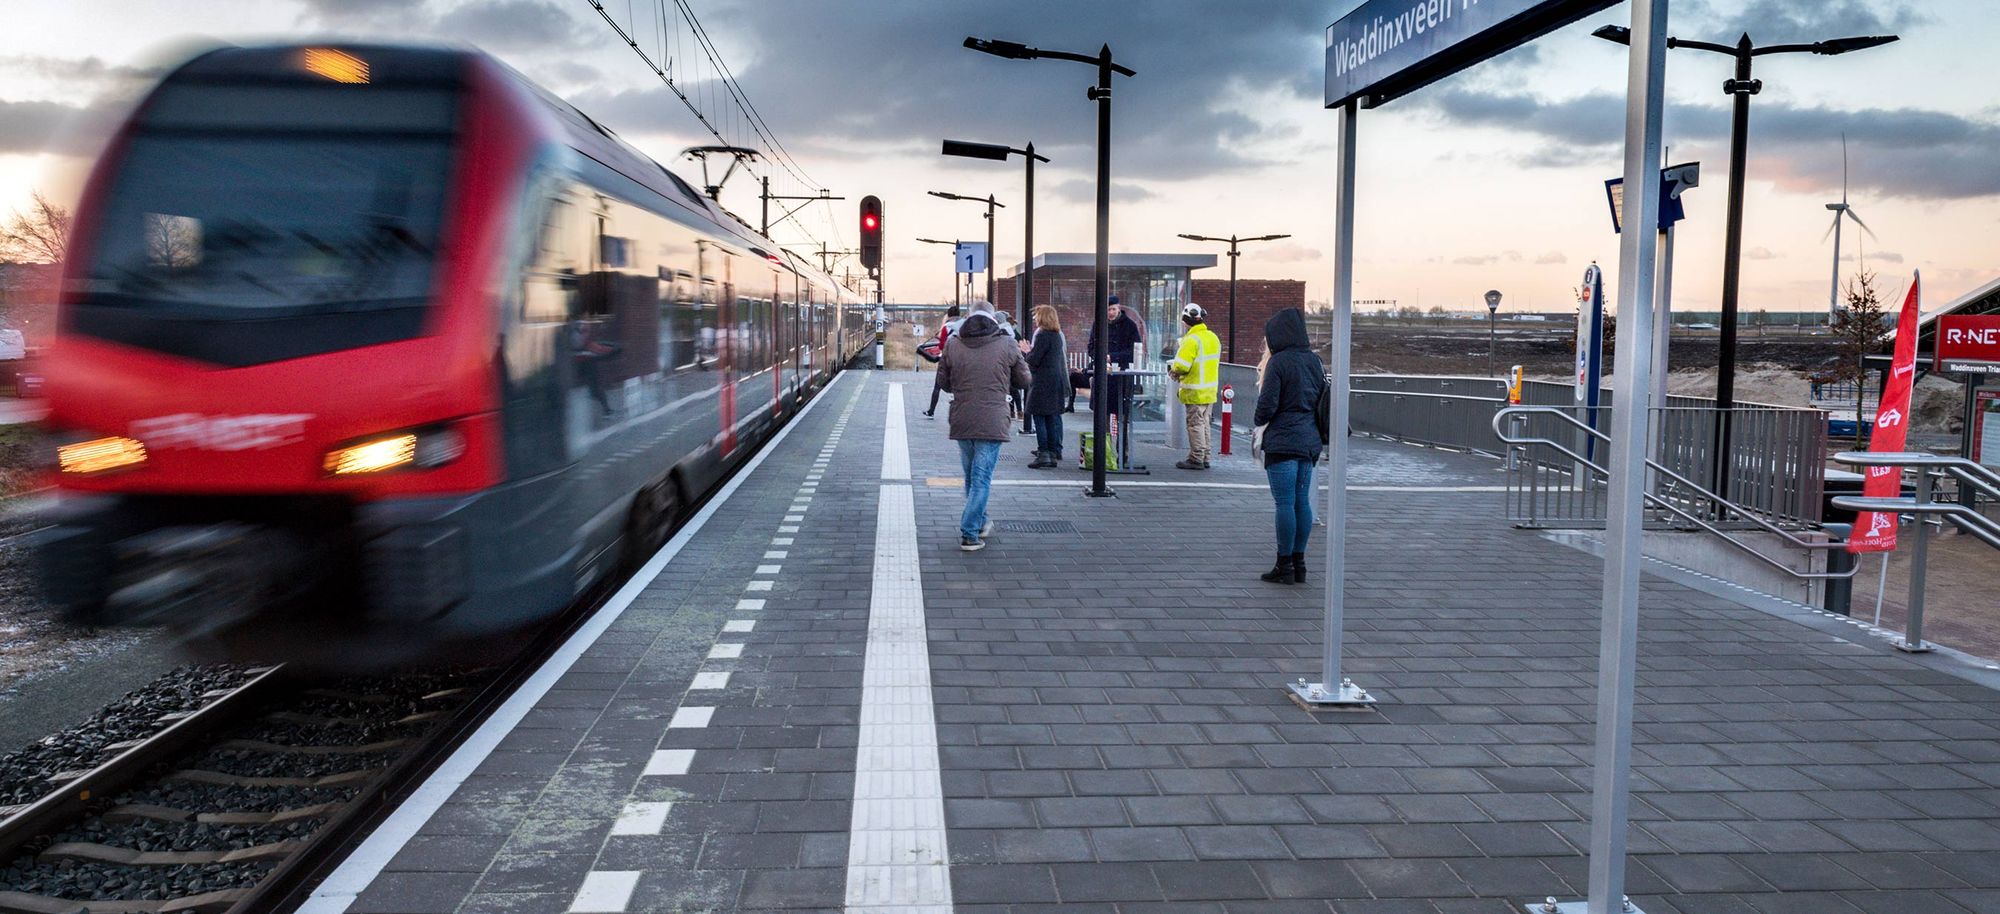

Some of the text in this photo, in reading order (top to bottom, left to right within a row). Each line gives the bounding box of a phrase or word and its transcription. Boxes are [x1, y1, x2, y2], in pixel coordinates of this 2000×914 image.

[1335, 0, 1451, 77] Waddinxveen
[966, 255, 973, 270] 1
[877, 322, 882, 330] P
